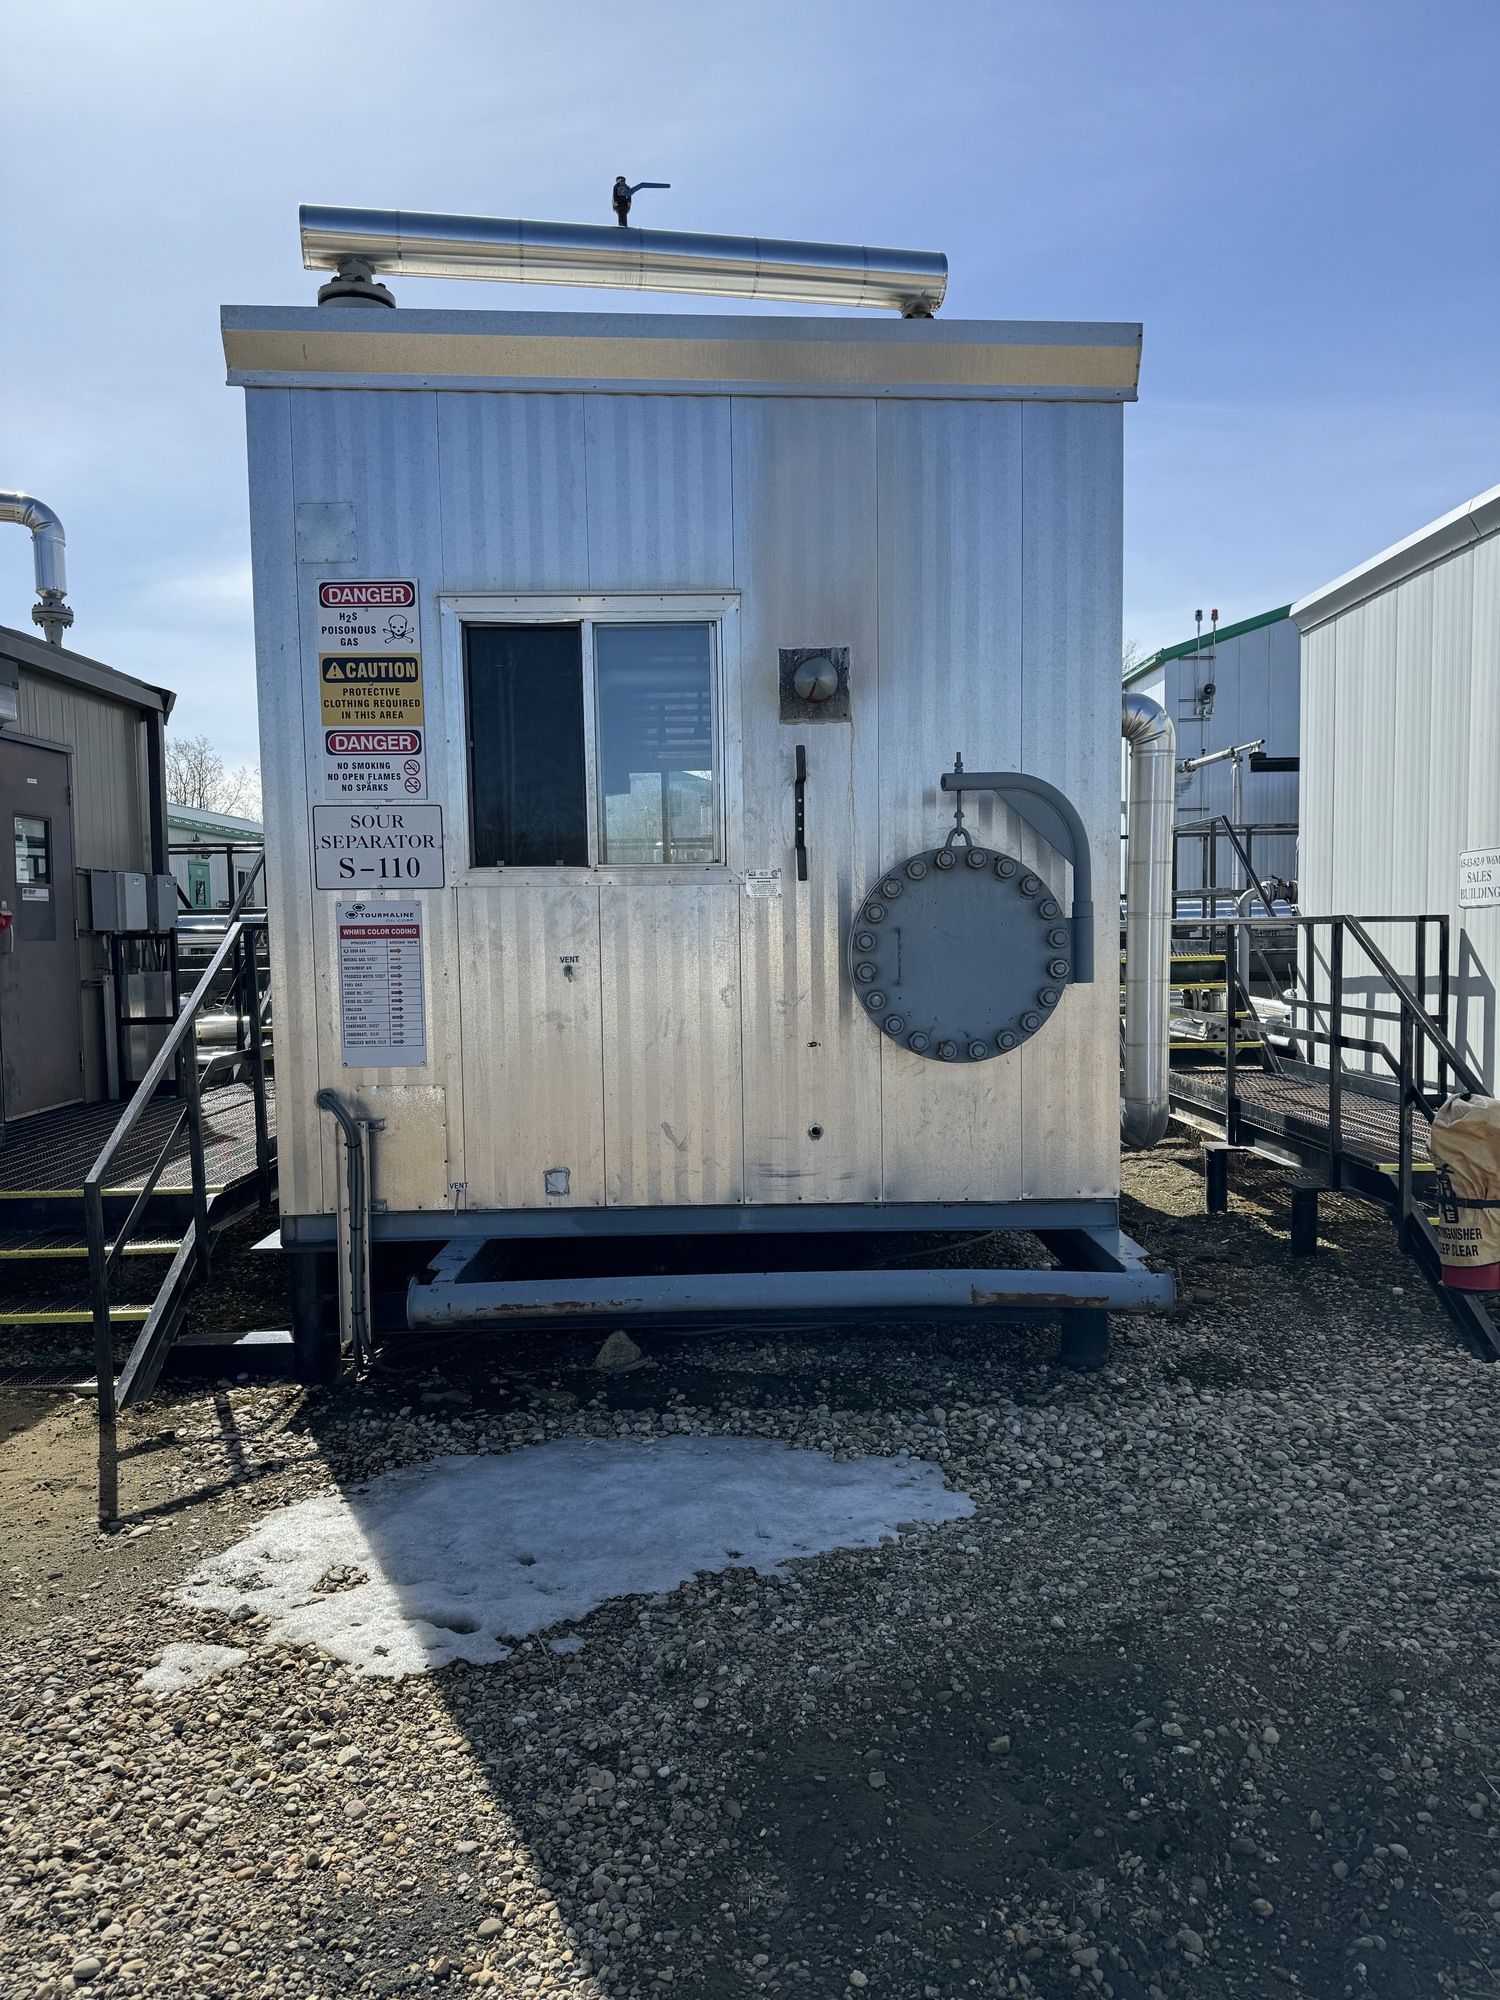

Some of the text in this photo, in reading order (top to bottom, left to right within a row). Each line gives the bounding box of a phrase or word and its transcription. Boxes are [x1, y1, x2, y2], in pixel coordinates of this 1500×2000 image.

[328, 587, 405, 603] DANGER
[339, 612, 358, 623] H2S
[321, 626, 377, 635] POISONOUS
[340, 638, 359, 646] GAS
[345, 662, 416, 678] CAUTION
[342, 688, 401, 696] PROTECTIVE
[323, 699, 420, 708] CLOTHING REQUIRED
[341, 711, 404, 719] IN THIS AREA
[335, 735, 412, 751] DANGER
[337, 762, 391, 770] NO SMOKING
[327, 773, 339, 781] NO
[341, 784, 389, 792] NO SPARKS
[350, 814, 404, 829] SOUR
[321, 834, 435, 849] SEPARATOR
[339, 857, 421, 879] S-110
[1467, 870, 1492, 883] SALES
[1460, 886, 1500, 900] BUILDING
[449, 1182, 469, 1190] VENT
[1451, 1244, 1480, 1257] CLEAR
